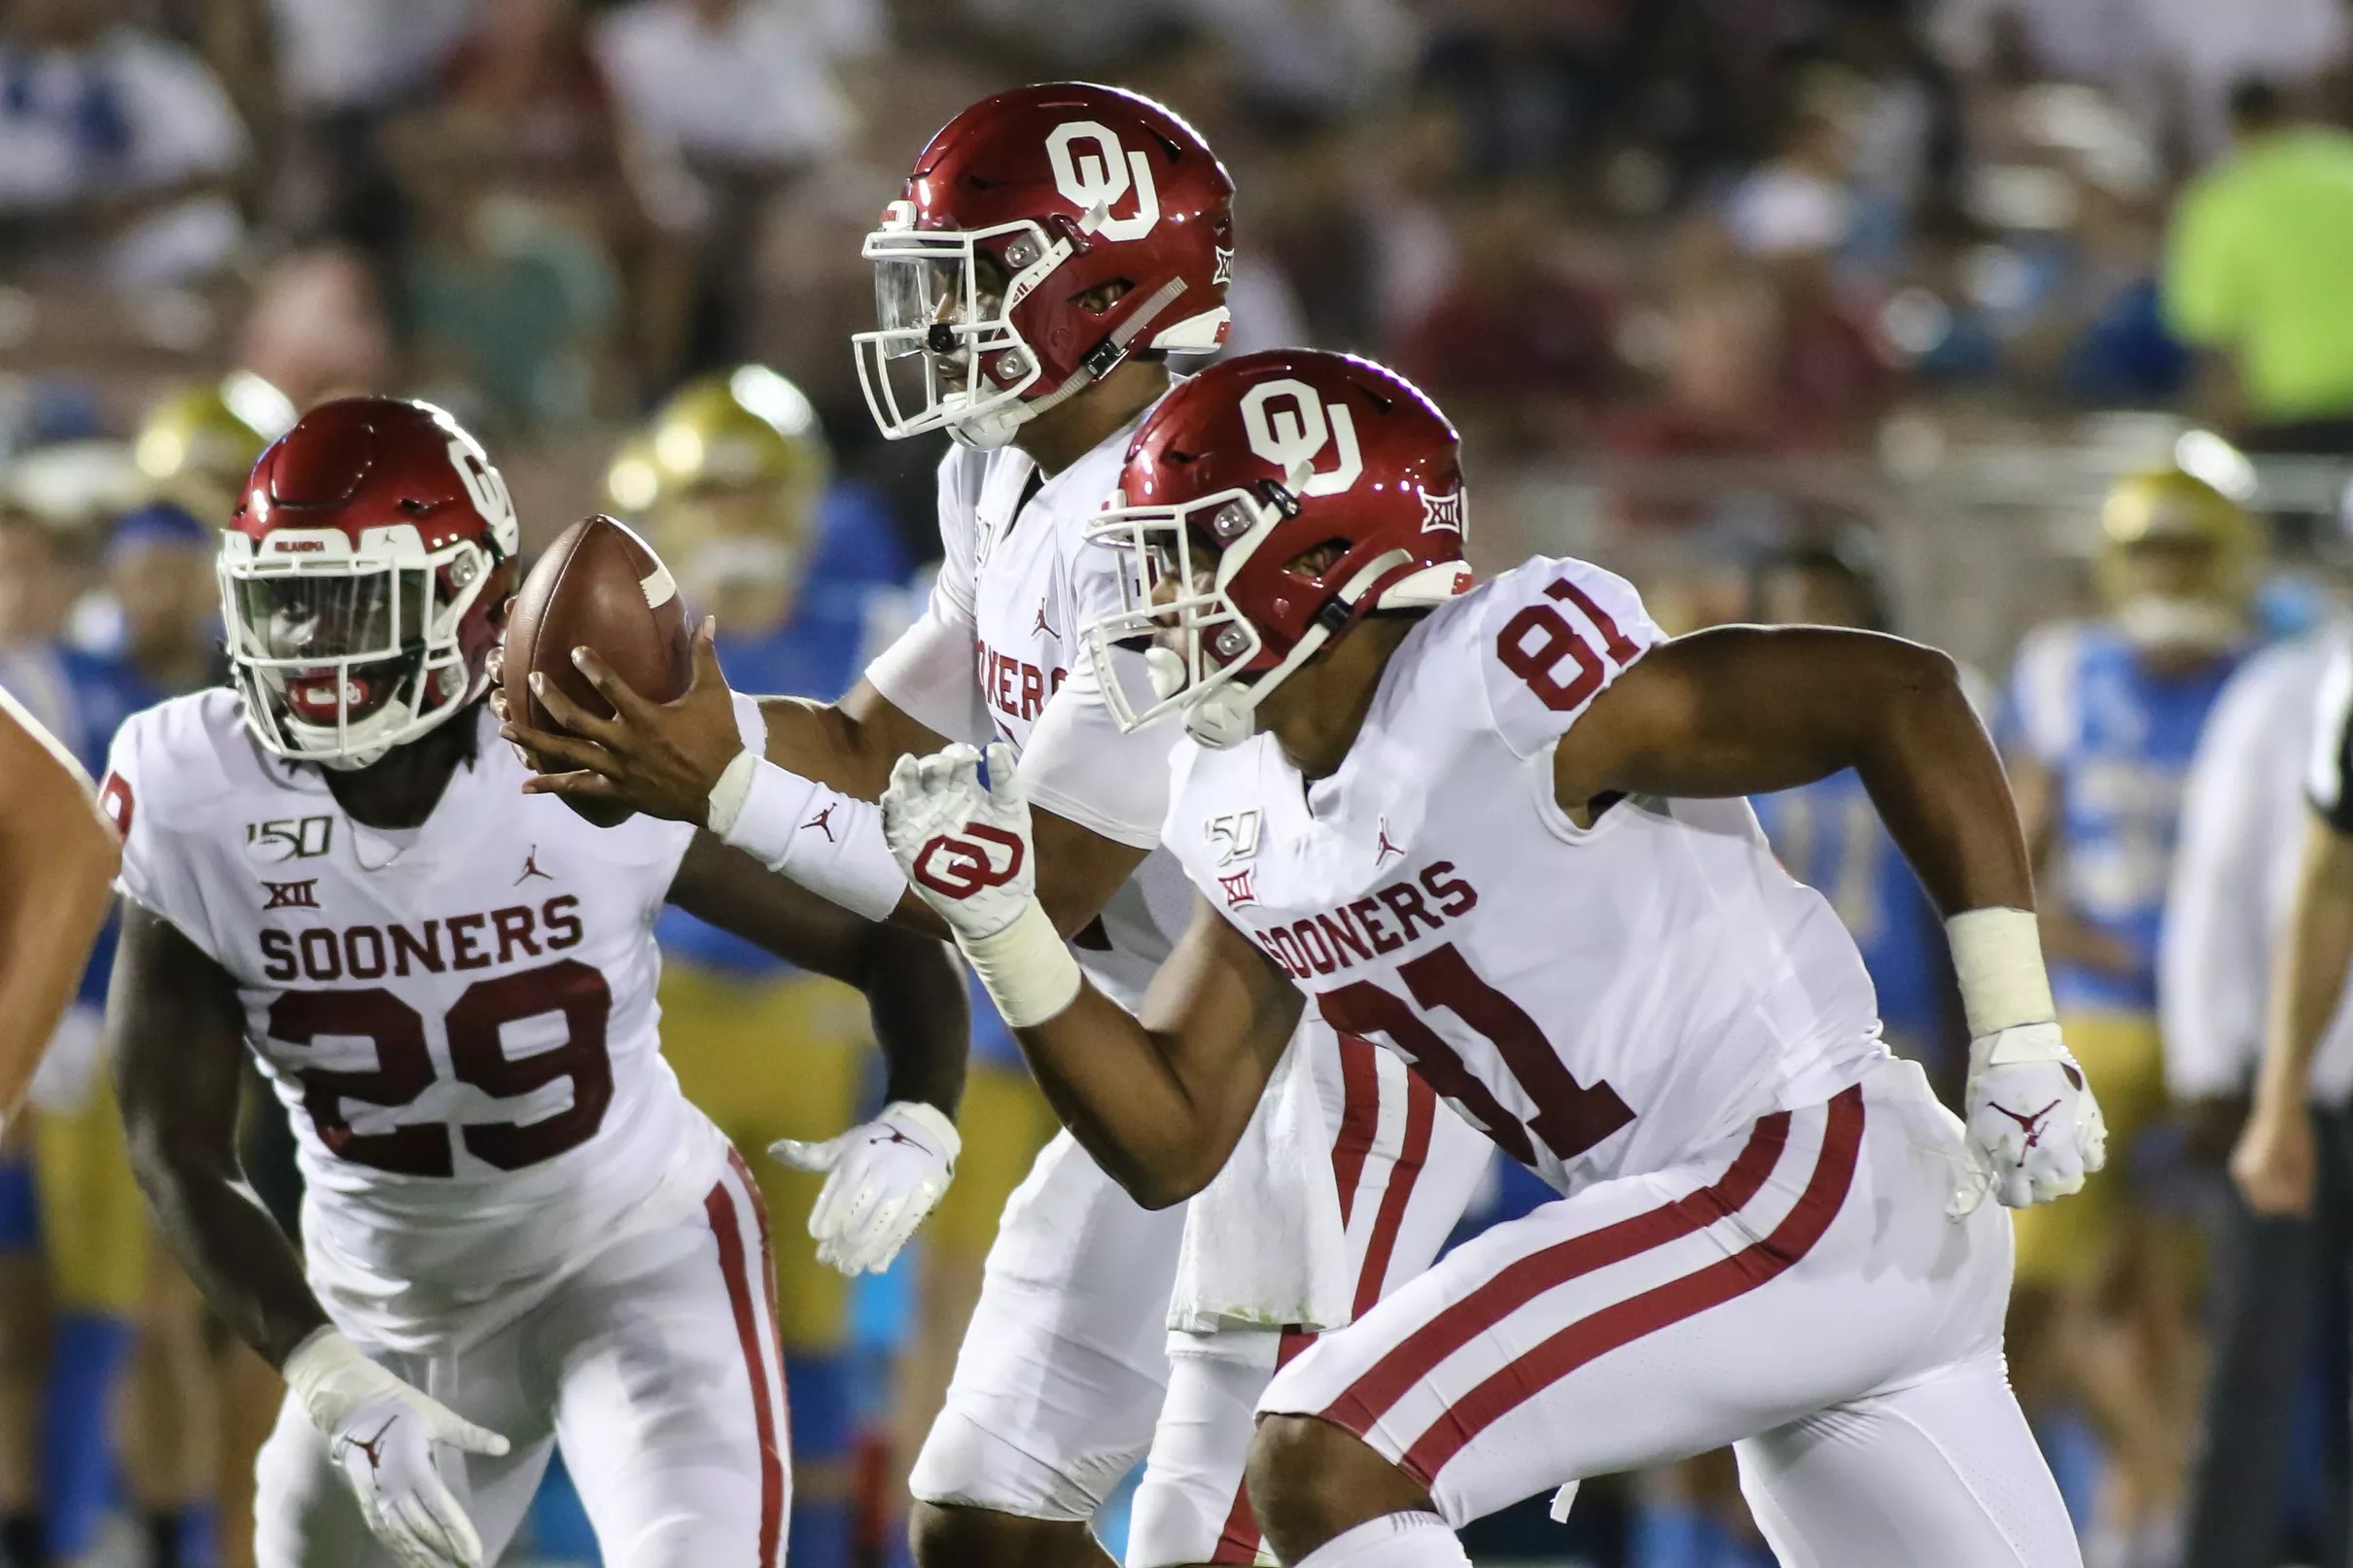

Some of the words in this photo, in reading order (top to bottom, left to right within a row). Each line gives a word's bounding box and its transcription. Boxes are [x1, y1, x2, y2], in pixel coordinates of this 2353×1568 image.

[1045, 121, 1160, 242] OU
[1240, 378, 1363, 498] OU
[1420, 492, 1459, 534] XII
[1496, 577, 1641, 711] 81
[260, 878, 321, 910] XII
[913, 821, 1024, 899] OU
[1217, 868, 1254, 906] XII
[260, 894, 583, 981] SOONERS
[1255, 861, 1478, 979] SOONERS
[267, 958, 615, 1177] 29
